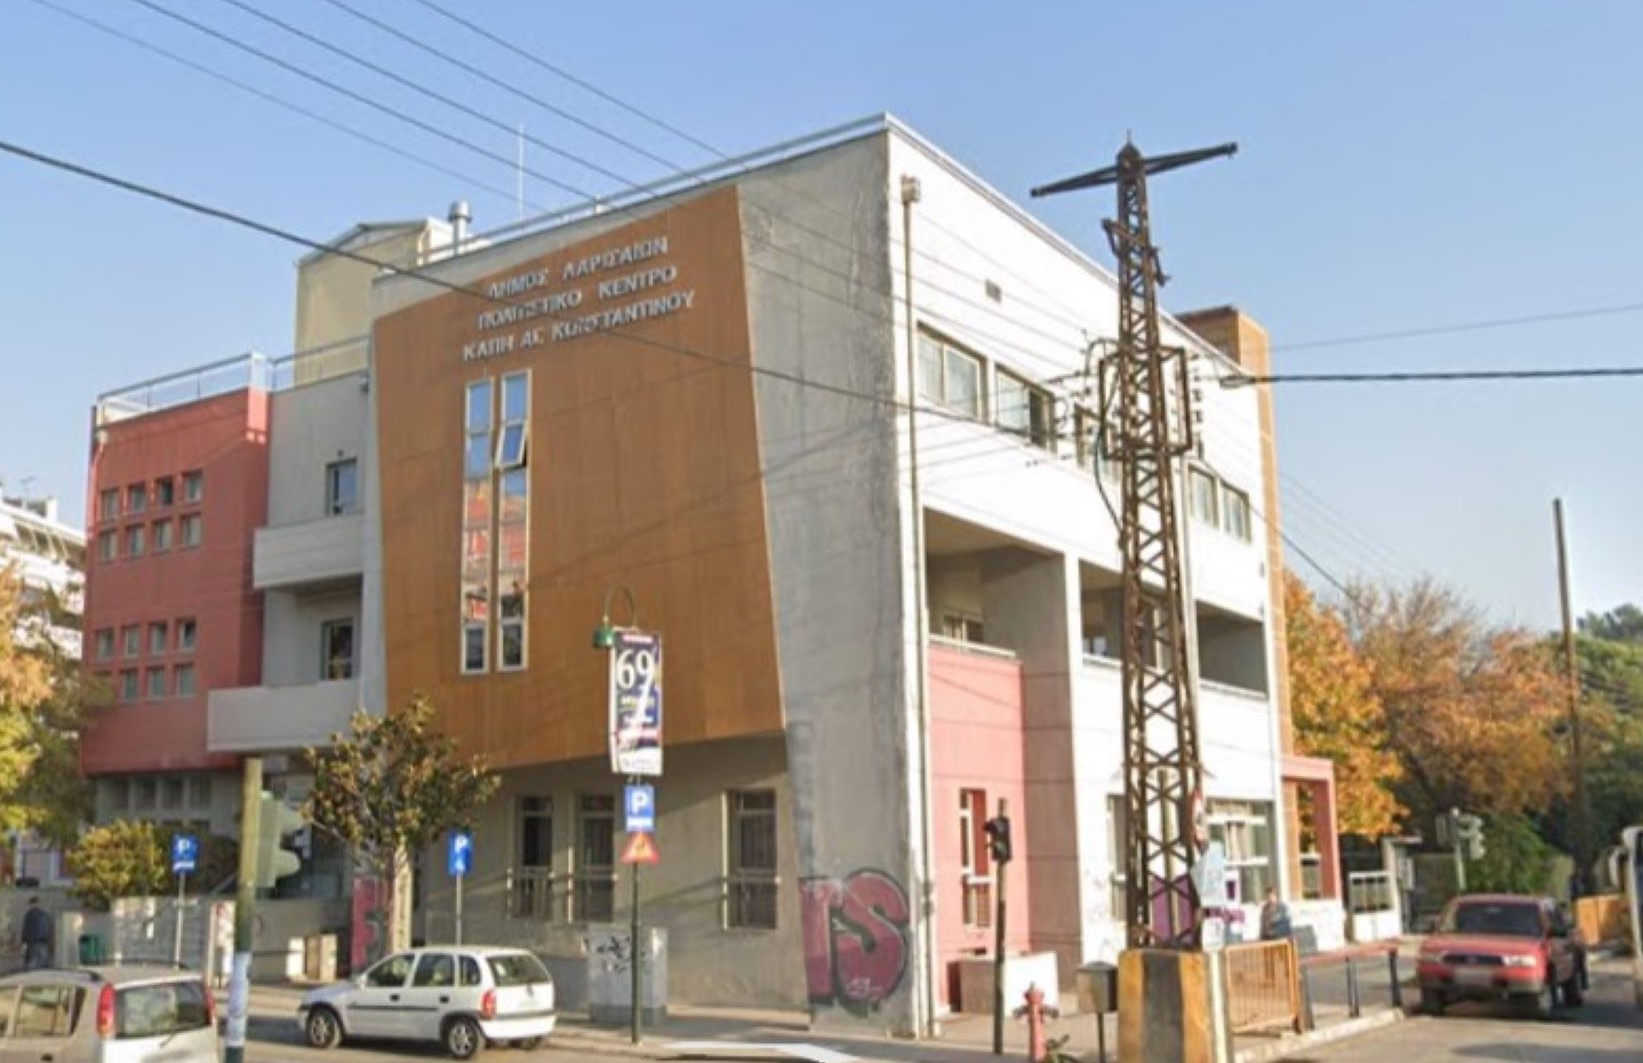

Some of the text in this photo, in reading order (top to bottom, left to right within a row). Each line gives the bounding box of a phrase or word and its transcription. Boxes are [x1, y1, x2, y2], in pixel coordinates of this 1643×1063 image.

[598, 265, 677, 301] ΚΕΝΤΡΟ
[463, 335, 514, 362] ΚΑΠΗ
[631, 791, 648, 814] P
